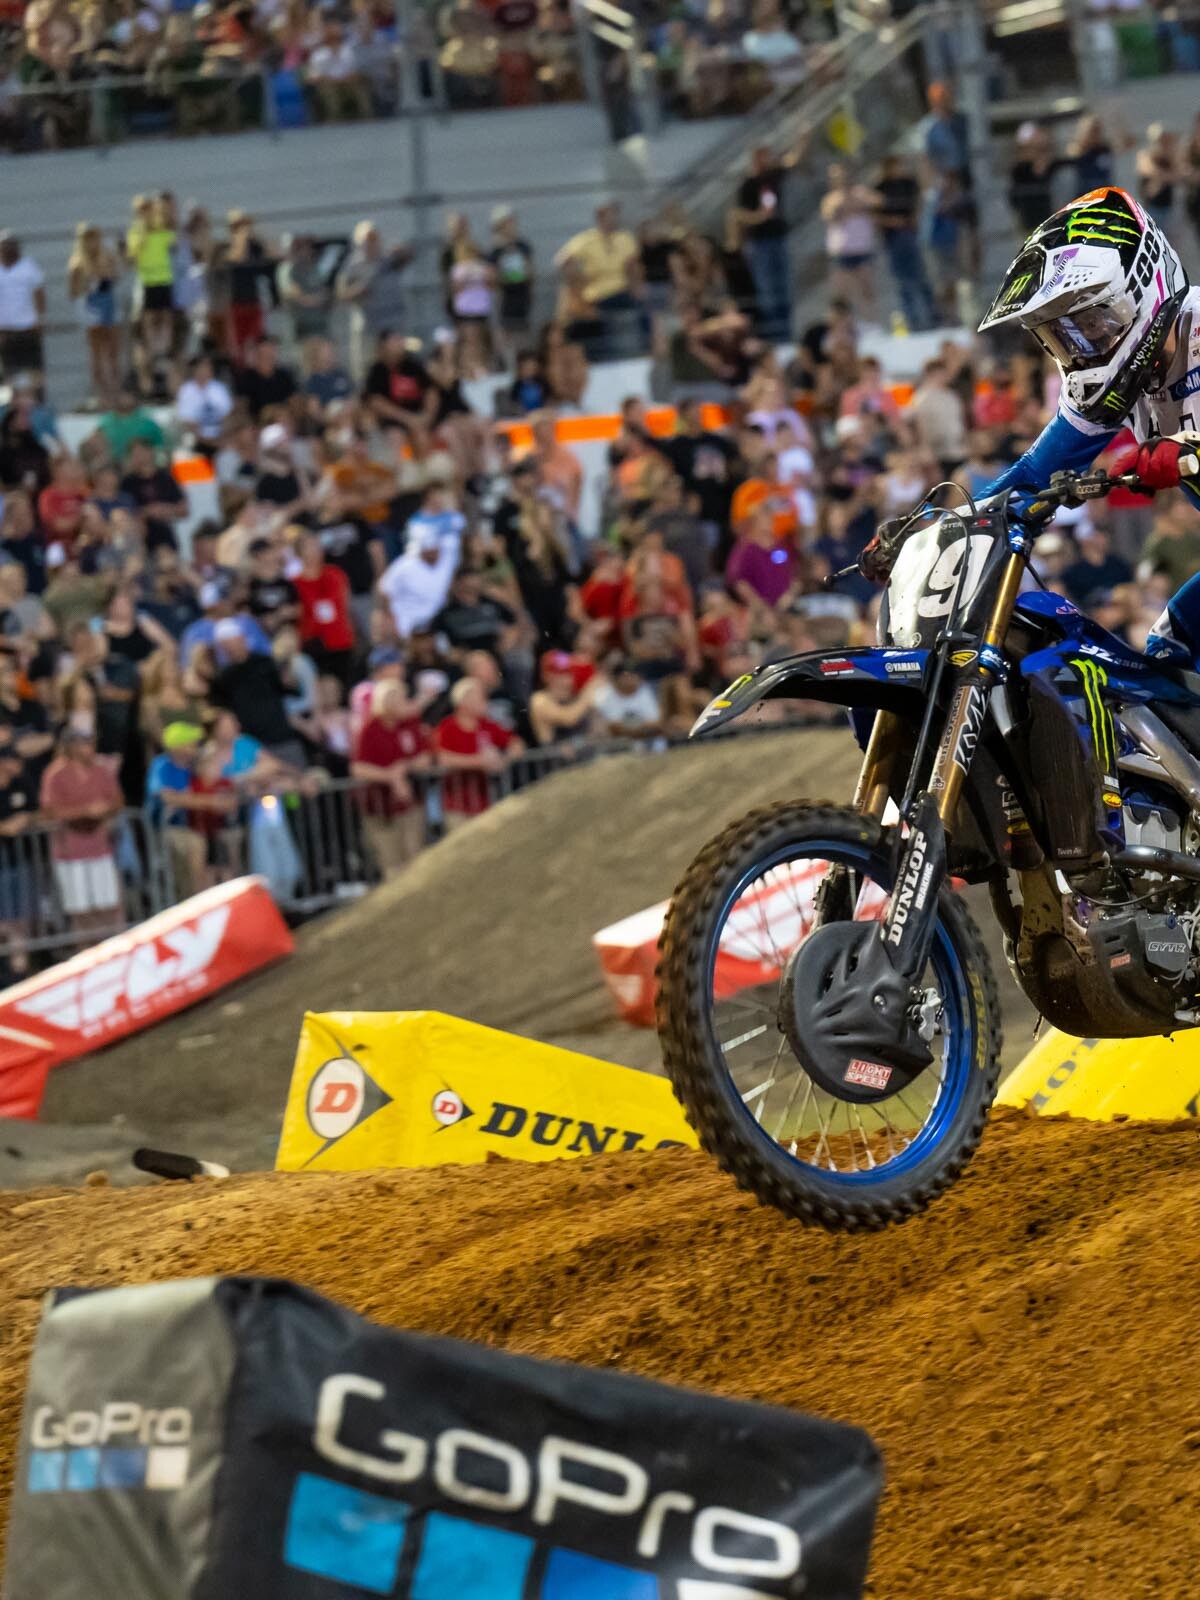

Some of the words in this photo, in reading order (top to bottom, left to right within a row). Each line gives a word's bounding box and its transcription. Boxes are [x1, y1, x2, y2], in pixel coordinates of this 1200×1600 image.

[918, 534, 995, 618] 9
[893, 662, 920, 671] YAMAHA
[888, 831, 927, 946] DUNLOP
[1148, 942, 1186, 953] GYTR
[848, 1060, 891, 1079] LIGHT
[480, 1102, 686, 1152] DUNL
[32, 1405, 191, 1444] GoPro
[314, 1374, 800, 1578] GoPro
